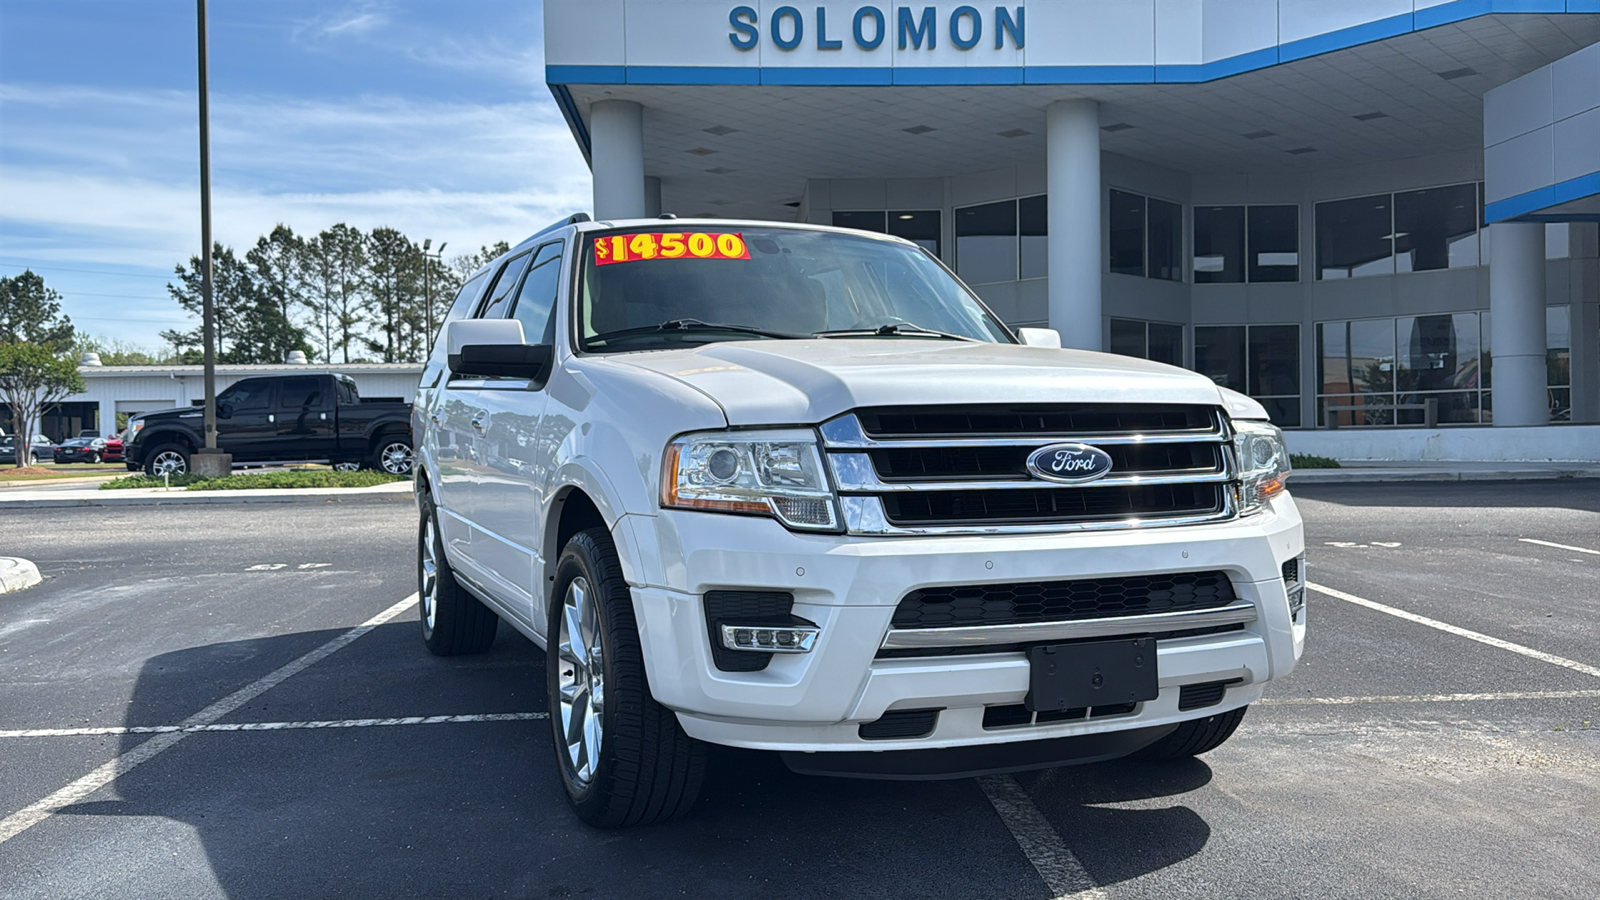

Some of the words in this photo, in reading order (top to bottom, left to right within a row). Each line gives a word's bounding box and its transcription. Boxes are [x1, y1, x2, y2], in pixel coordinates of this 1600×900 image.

[728, 6, 1025, 50] SOLOMON
[596, 232, 745, 261] $14500
[1051, 450, 1096, 472] Ford
